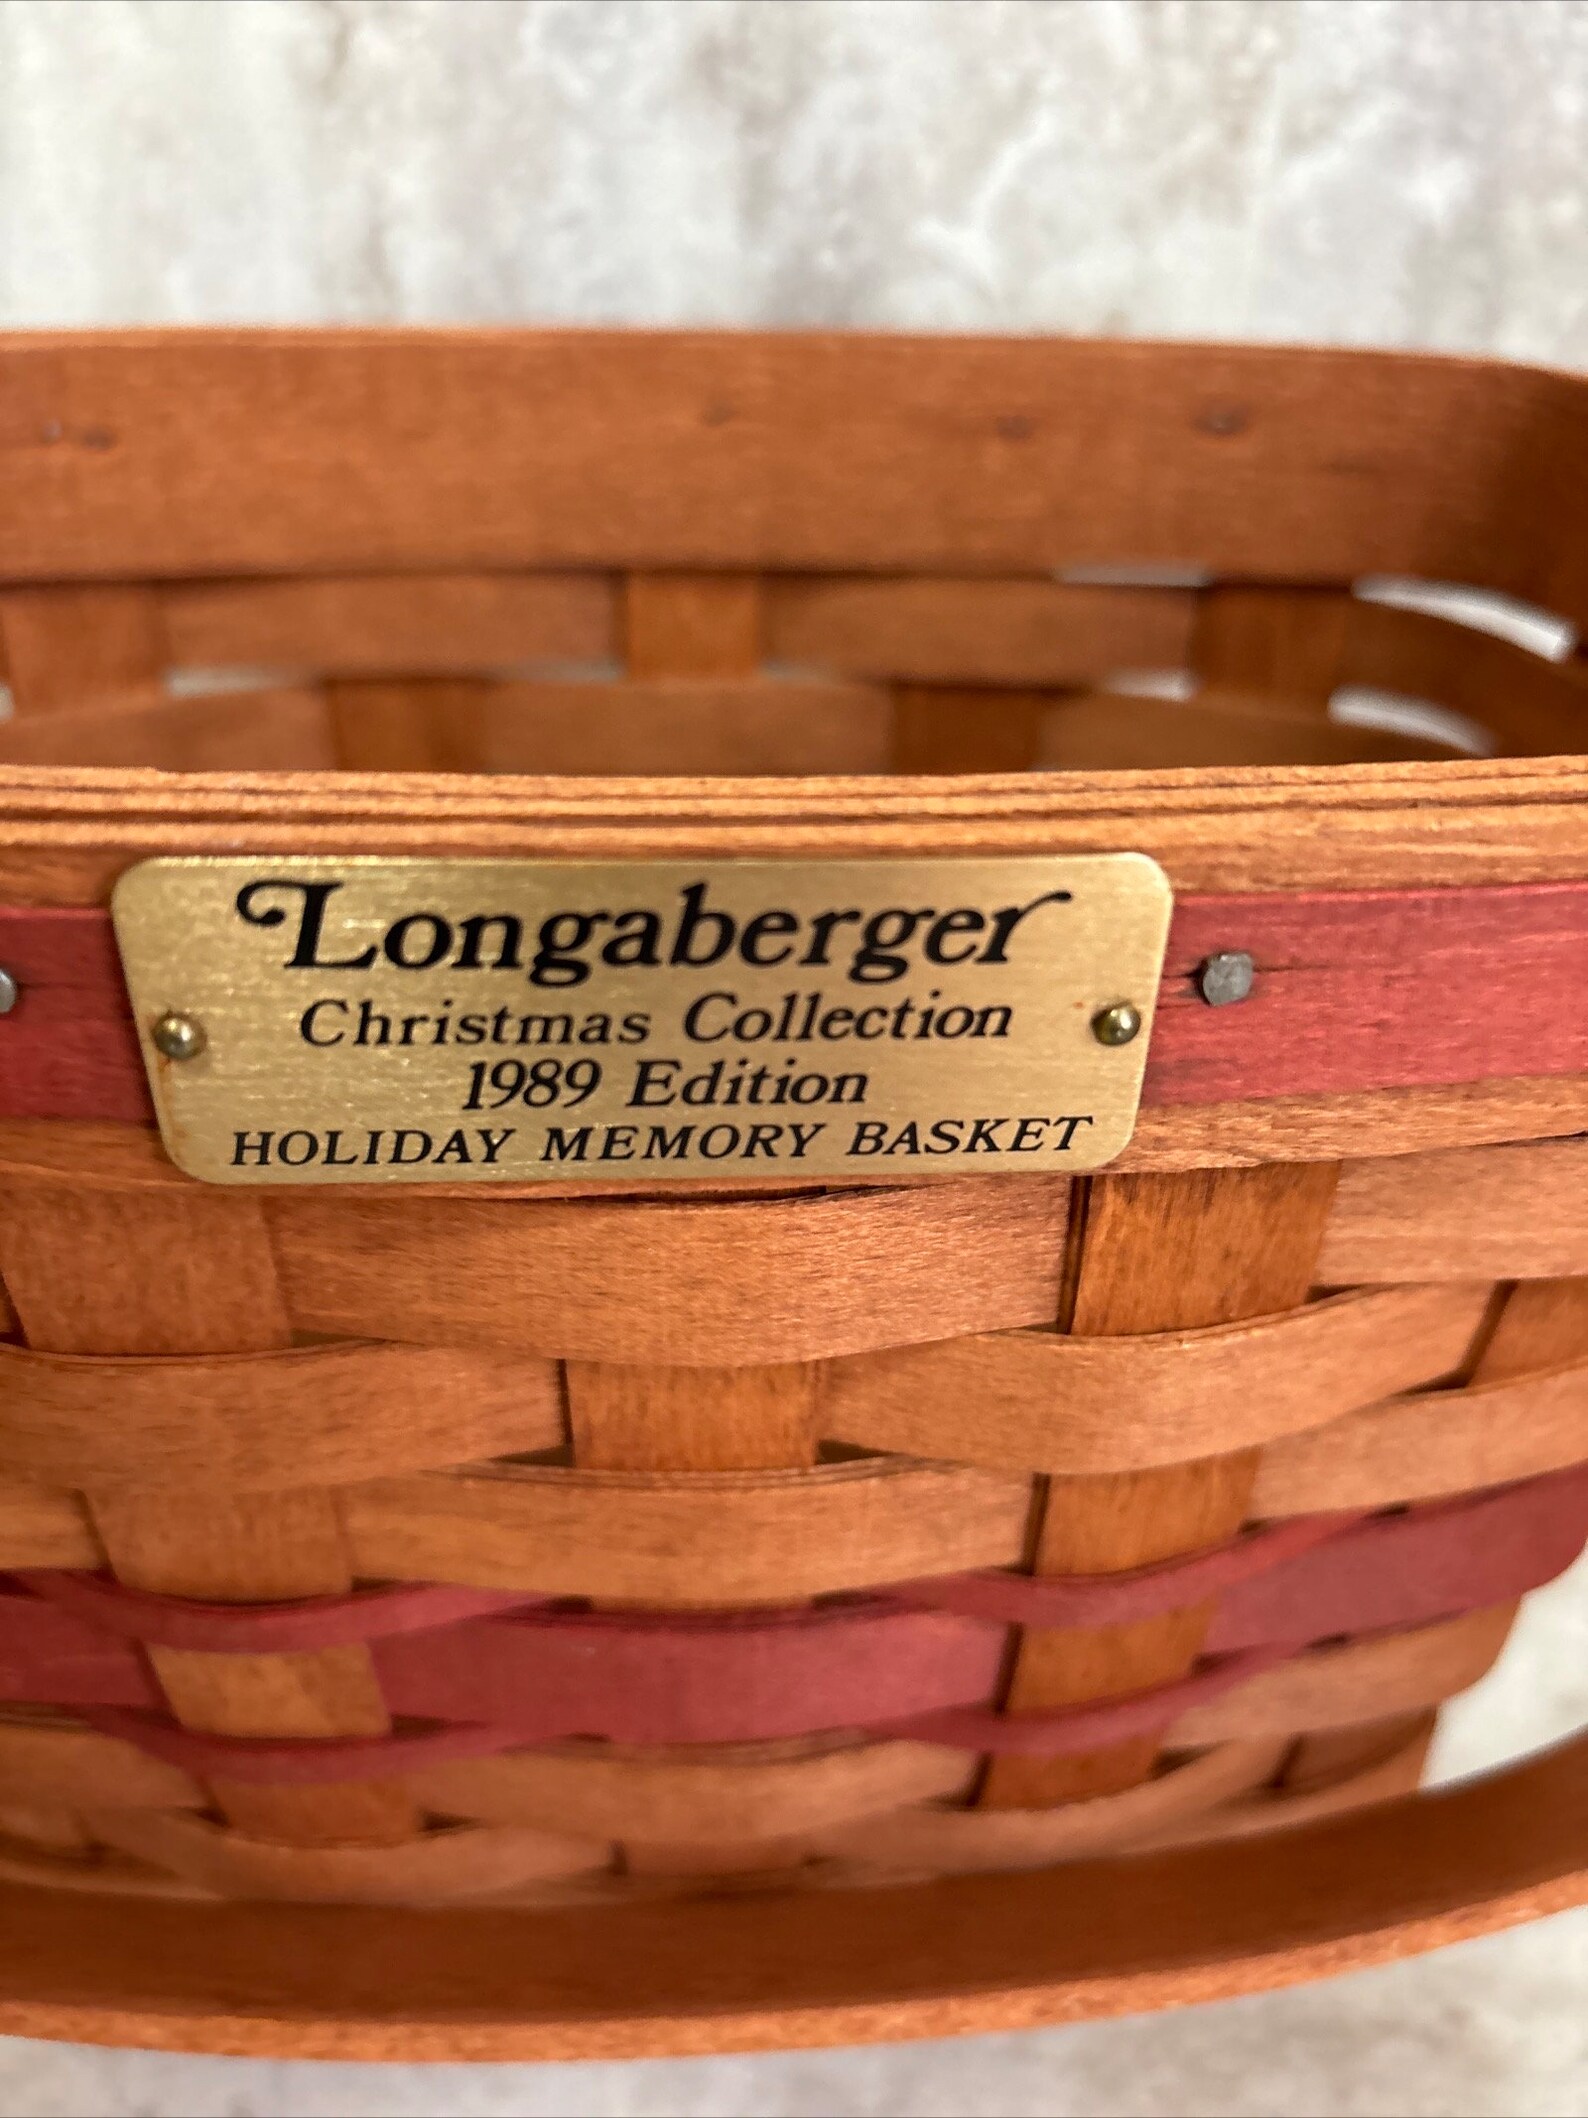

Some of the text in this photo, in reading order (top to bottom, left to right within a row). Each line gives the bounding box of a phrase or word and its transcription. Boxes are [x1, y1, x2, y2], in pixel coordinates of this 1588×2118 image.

[235, 879, 1072, 989] Longaberger
[299, 990, 1013, 1047] Christmas Collection
[460, 1058, 868, 1111] 1989 Edition
[230, 1116, 1094, 1166] HOLIDAY MEMORY BASKET
